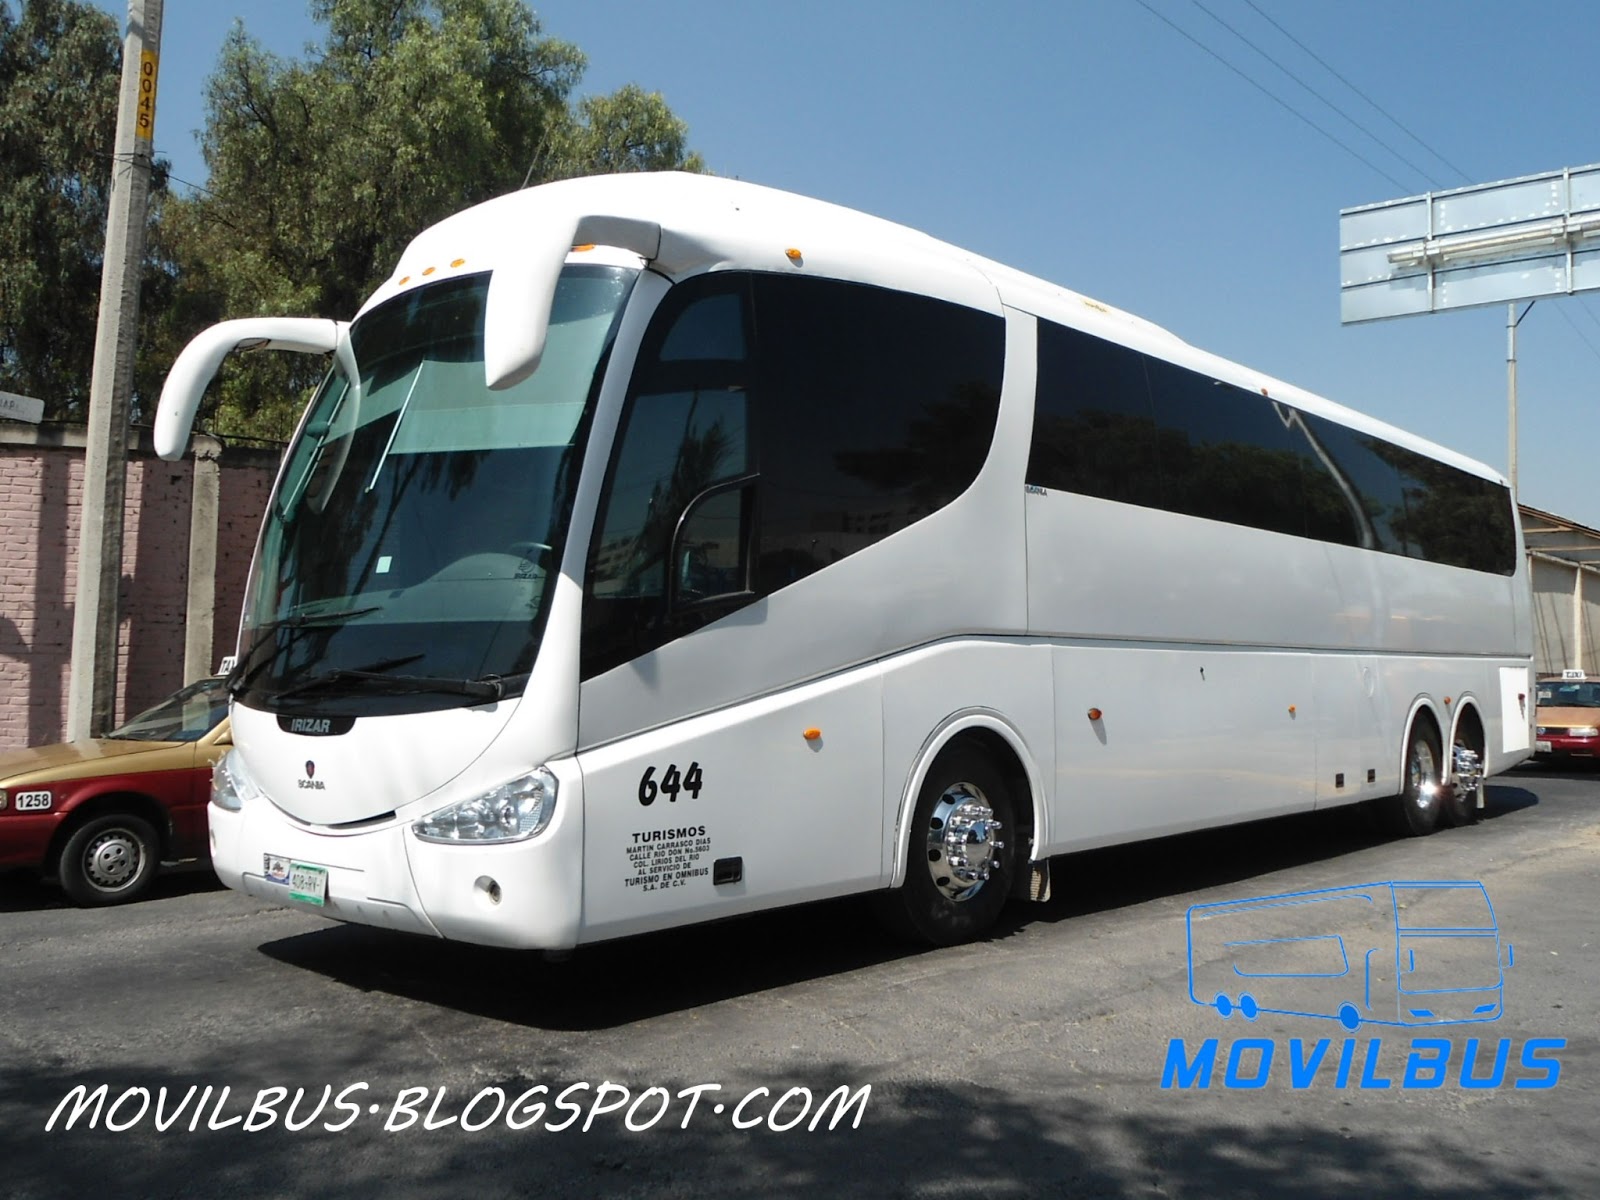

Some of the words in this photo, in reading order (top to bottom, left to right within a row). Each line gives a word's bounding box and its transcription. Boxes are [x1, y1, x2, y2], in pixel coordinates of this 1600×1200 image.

[140, 62, 153, 128] 0045
[291, 719, 331, 733] IRIZAR
[298, 780, 325, 791] SCANIA
[638, 761, 703, 807] 644
[18, 793, 49, 808] 1258
[632, 825, 706, 844] TURISMOS
[626, 845, 654, 854] MARTIN
[656, 840, 694, 851] CARRASCO
[629, 852, 651, 861] CALLE
[653, 850, 666, 858] RIO
[668, 848, 682, 856] DON
[651, 857, 672, 866] LIRIOS
[674, 855, 687, 863] DEL
[688, 853, 700, 861] RIO
[625, 875, 659, 887] TURISMO
[662, 873, 673, 881] EN
[675, 867, 709, 879] OMNIBUS
[638, 868, 647, 876] AL
[649, 864, 680, 874] SERVICIO
[660, 881, 669, 889] DE
